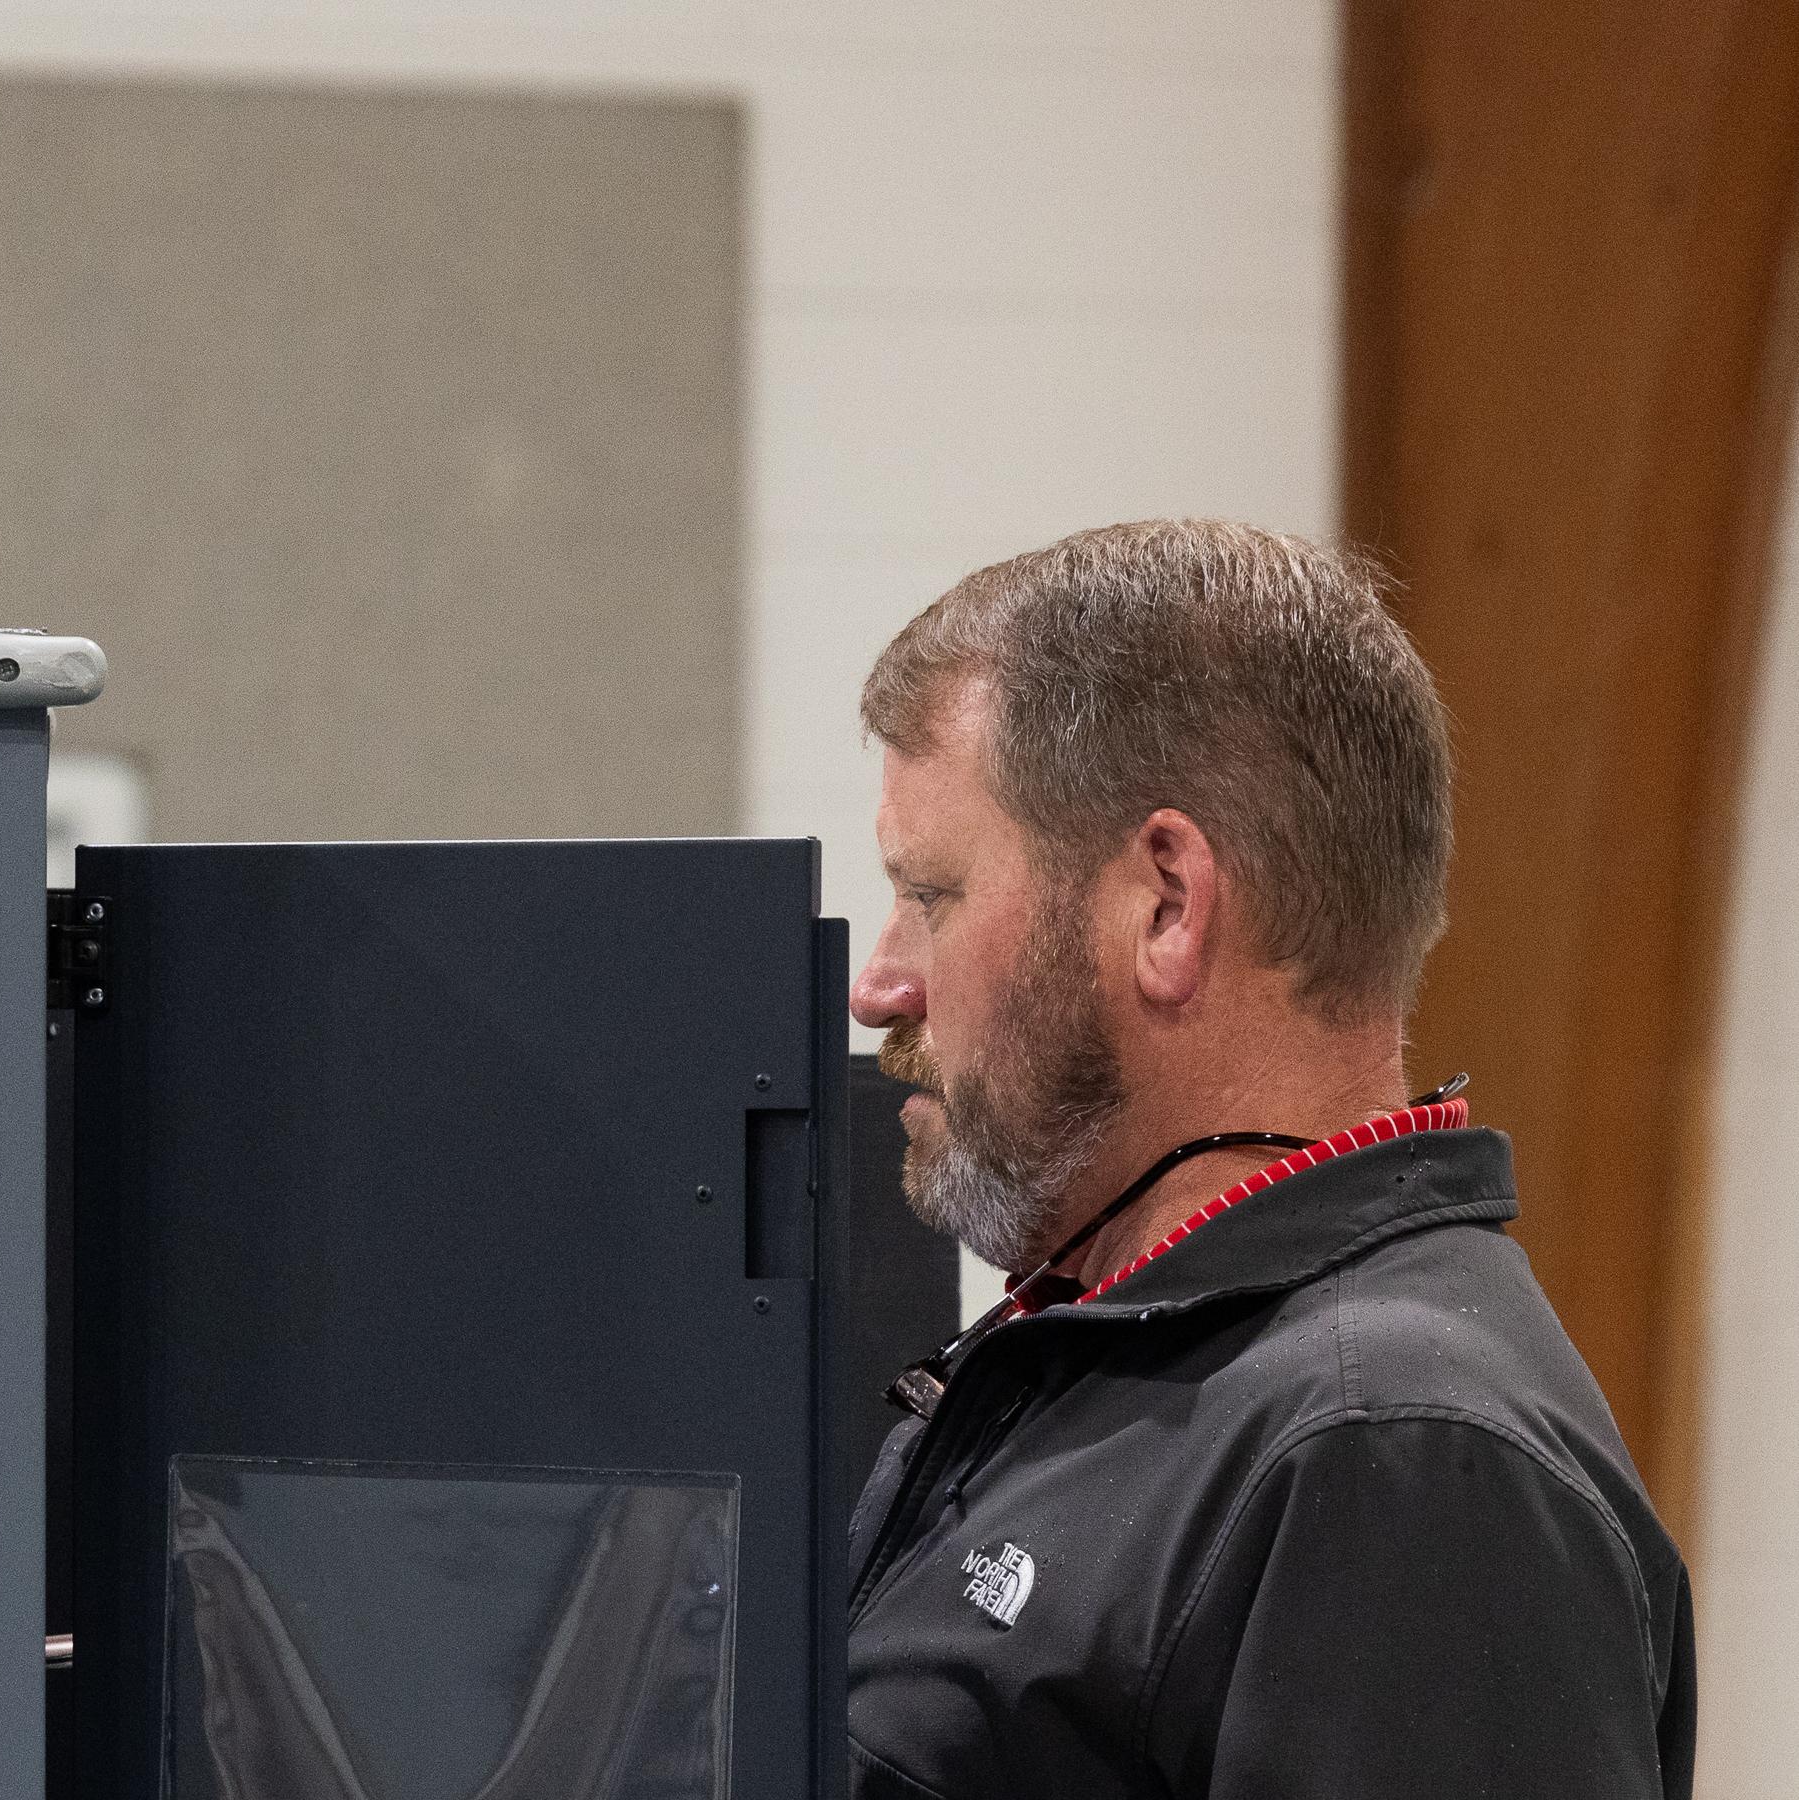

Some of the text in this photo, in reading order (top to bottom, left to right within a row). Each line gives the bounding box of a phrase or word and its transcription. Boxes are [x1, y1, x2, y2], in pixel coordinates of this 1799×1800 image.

[961, 1549, 1013, 1592] NORTH
[999, 1542, 1026, 1571] THE
[963, 1579, 1003, 1615] FACE
